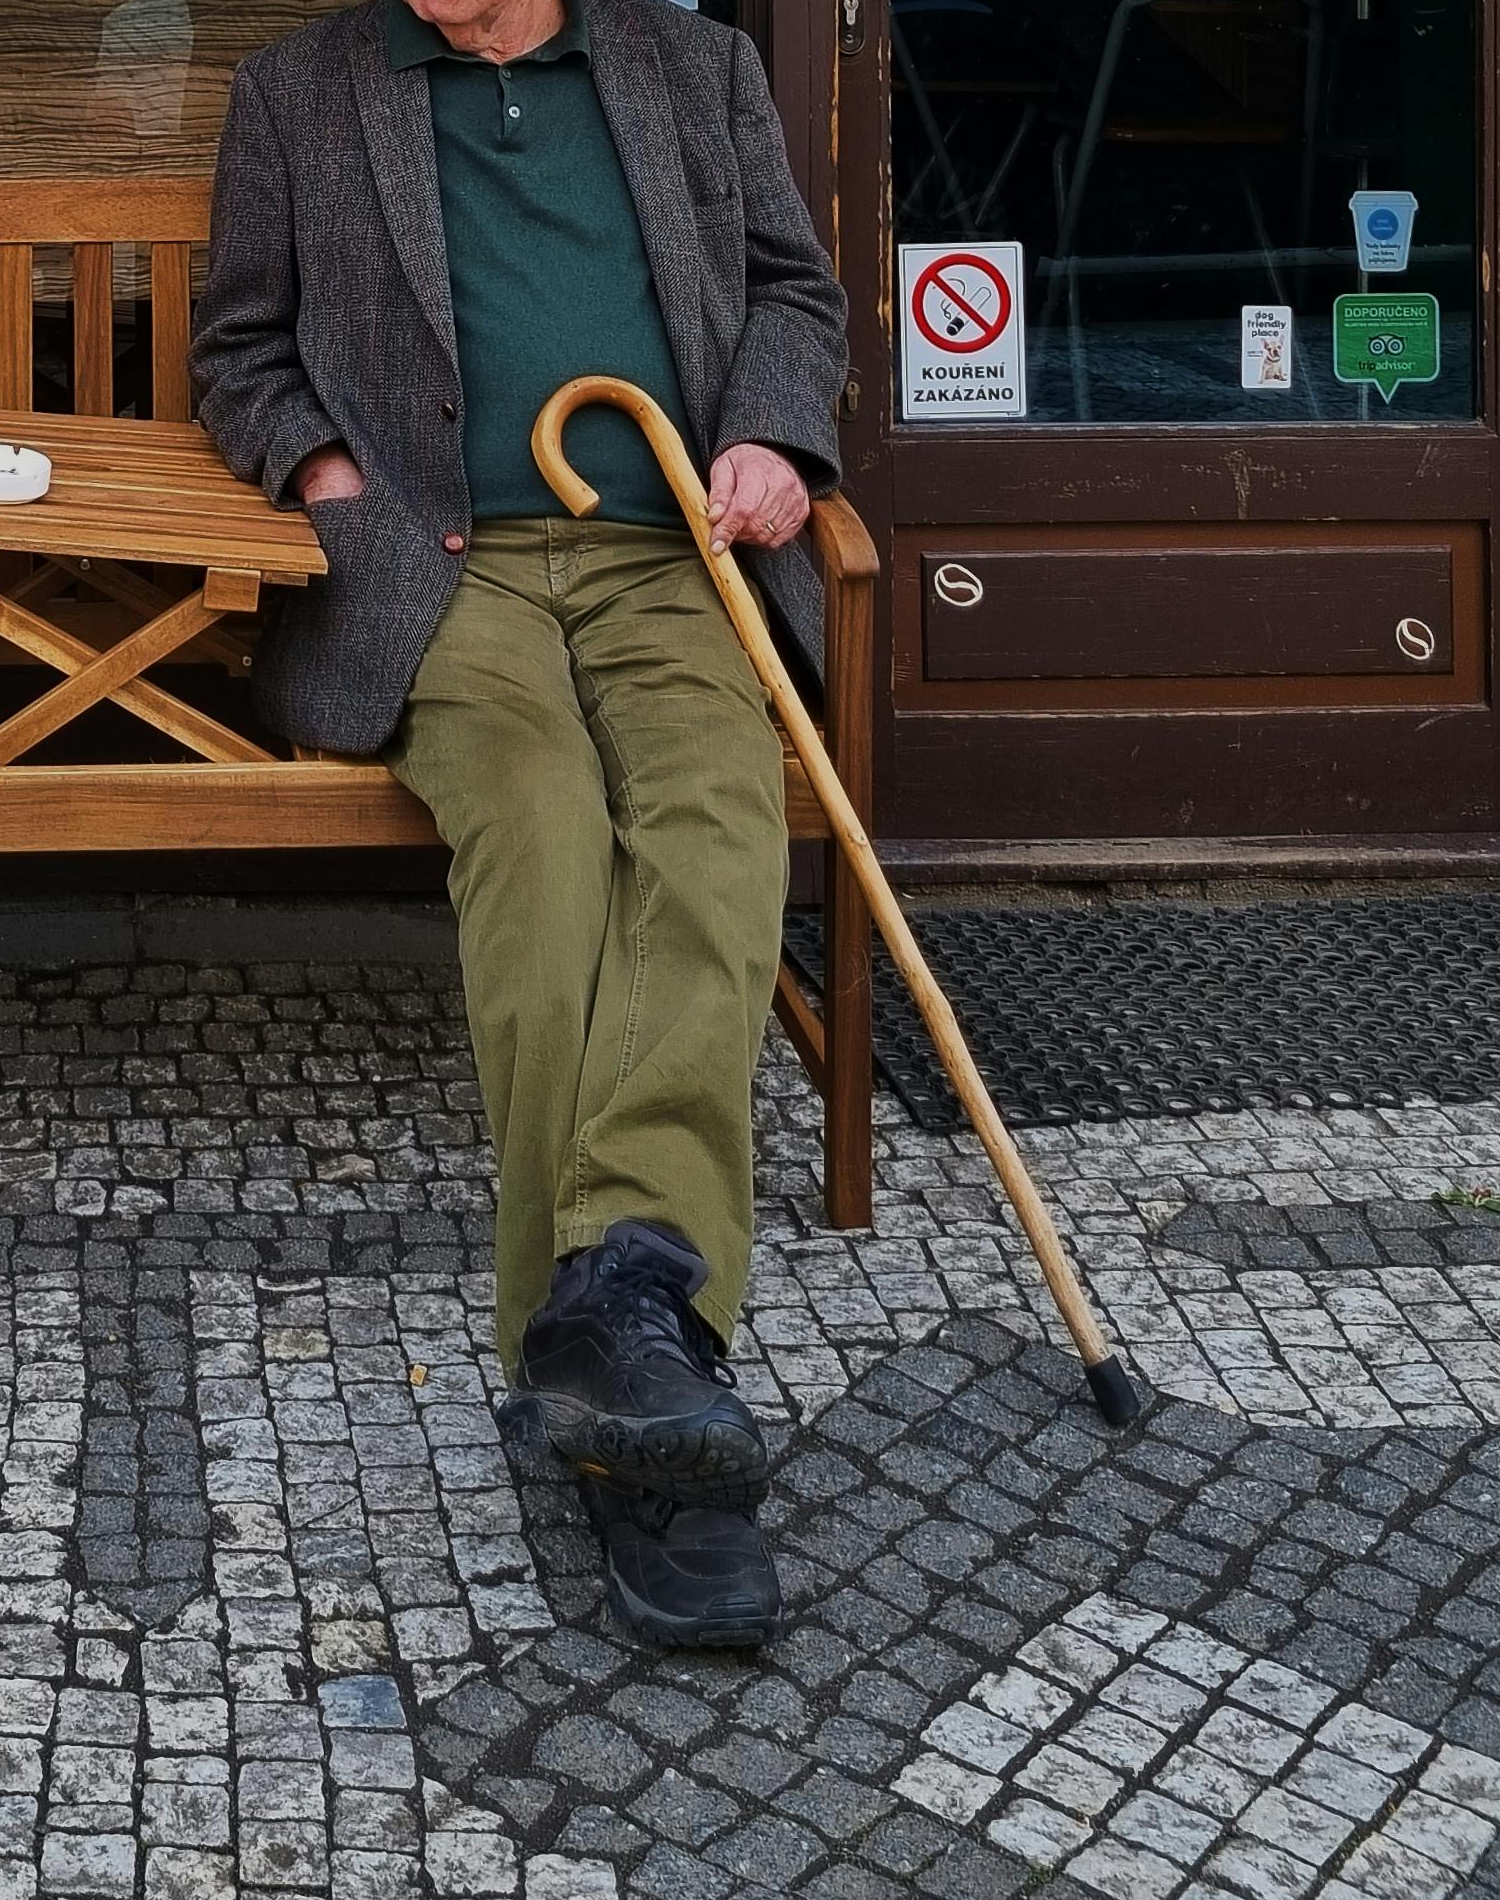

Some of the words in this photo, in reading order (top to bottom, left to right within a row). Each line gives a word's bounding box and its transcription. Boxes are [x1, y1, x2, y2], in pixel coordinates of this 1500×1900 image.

[1255, 311, 1274, 321] dog
[1344, 306, 1428, 318] DOPORUČENO
[1247, 319, 1286, 330] friendly
[1251, 329, 1279, 338] place
[921, 362, 1005, 380] KOUŘENÍ
[913, 384, 1014, 402] ZAKÁZÁNO
